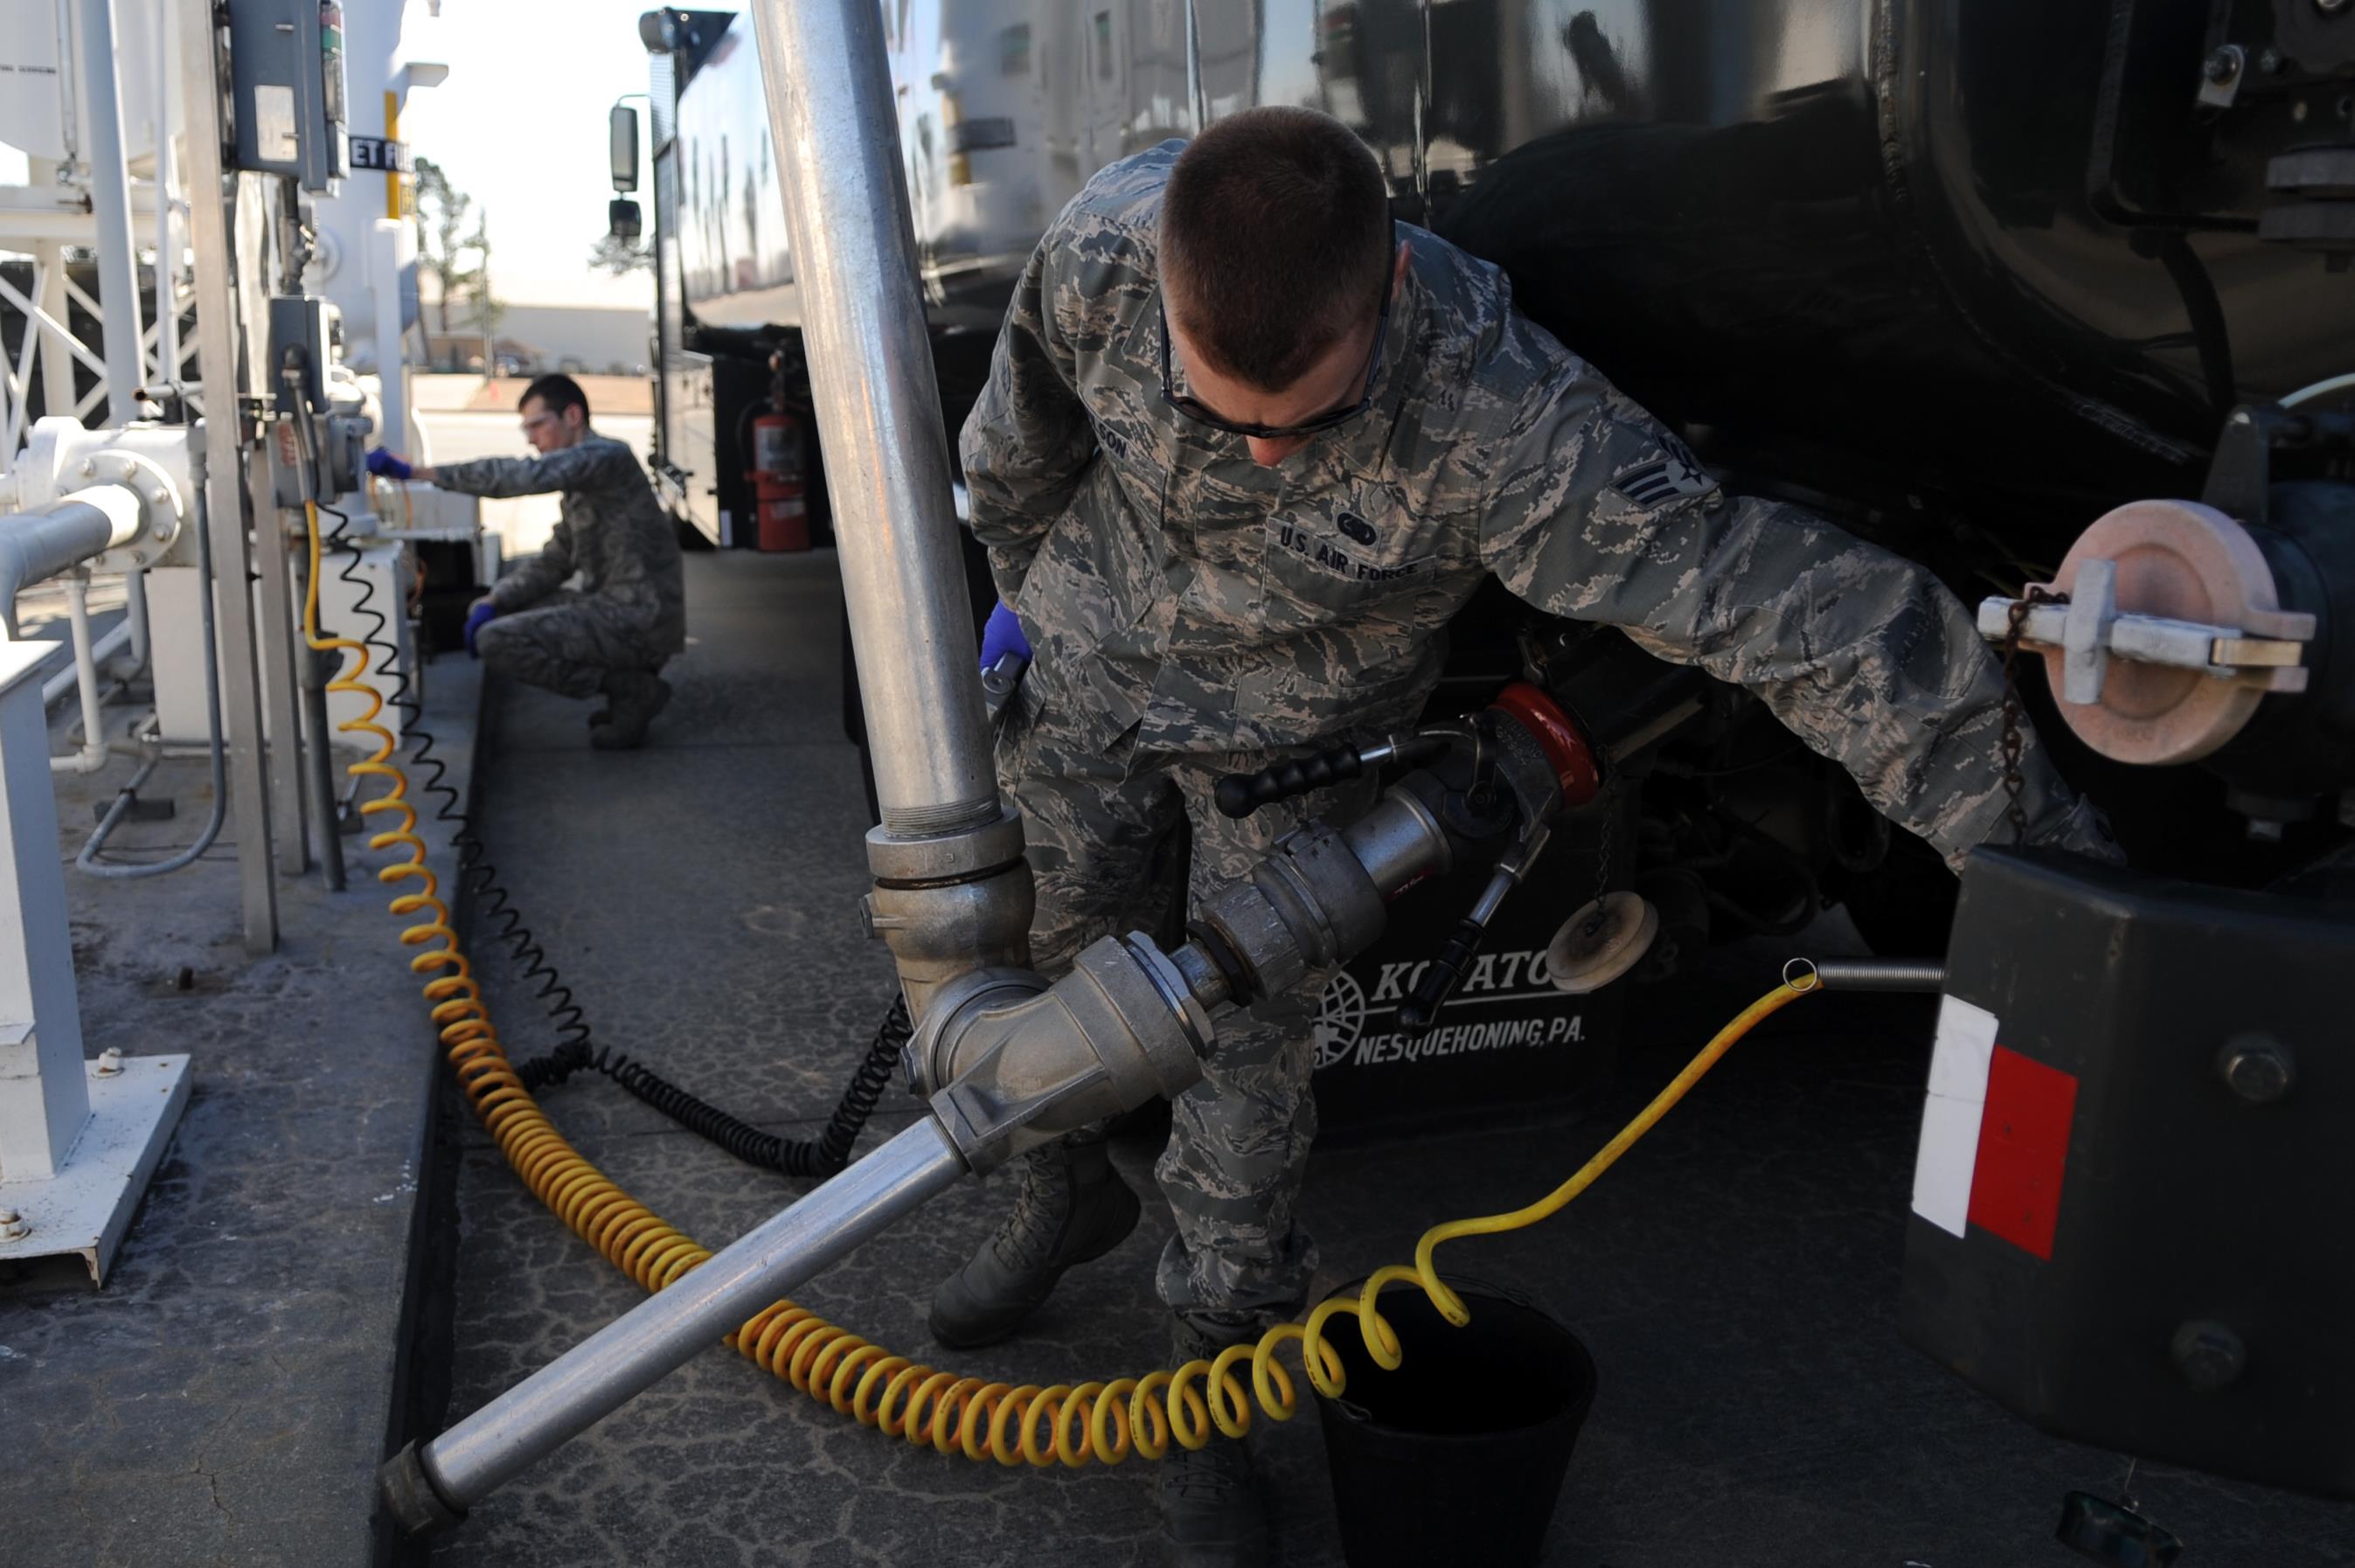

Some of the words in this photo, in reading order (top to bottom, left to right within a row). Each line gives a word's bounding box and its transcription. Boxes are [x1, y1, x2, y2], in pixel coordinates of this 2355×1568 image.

[351, 139, 379, 167] ET
[1281, 526, 1309, 556] U.S.
[1316, 545, 1348, 573] AIR
[1358, 564, 1418, 580] FORCE
